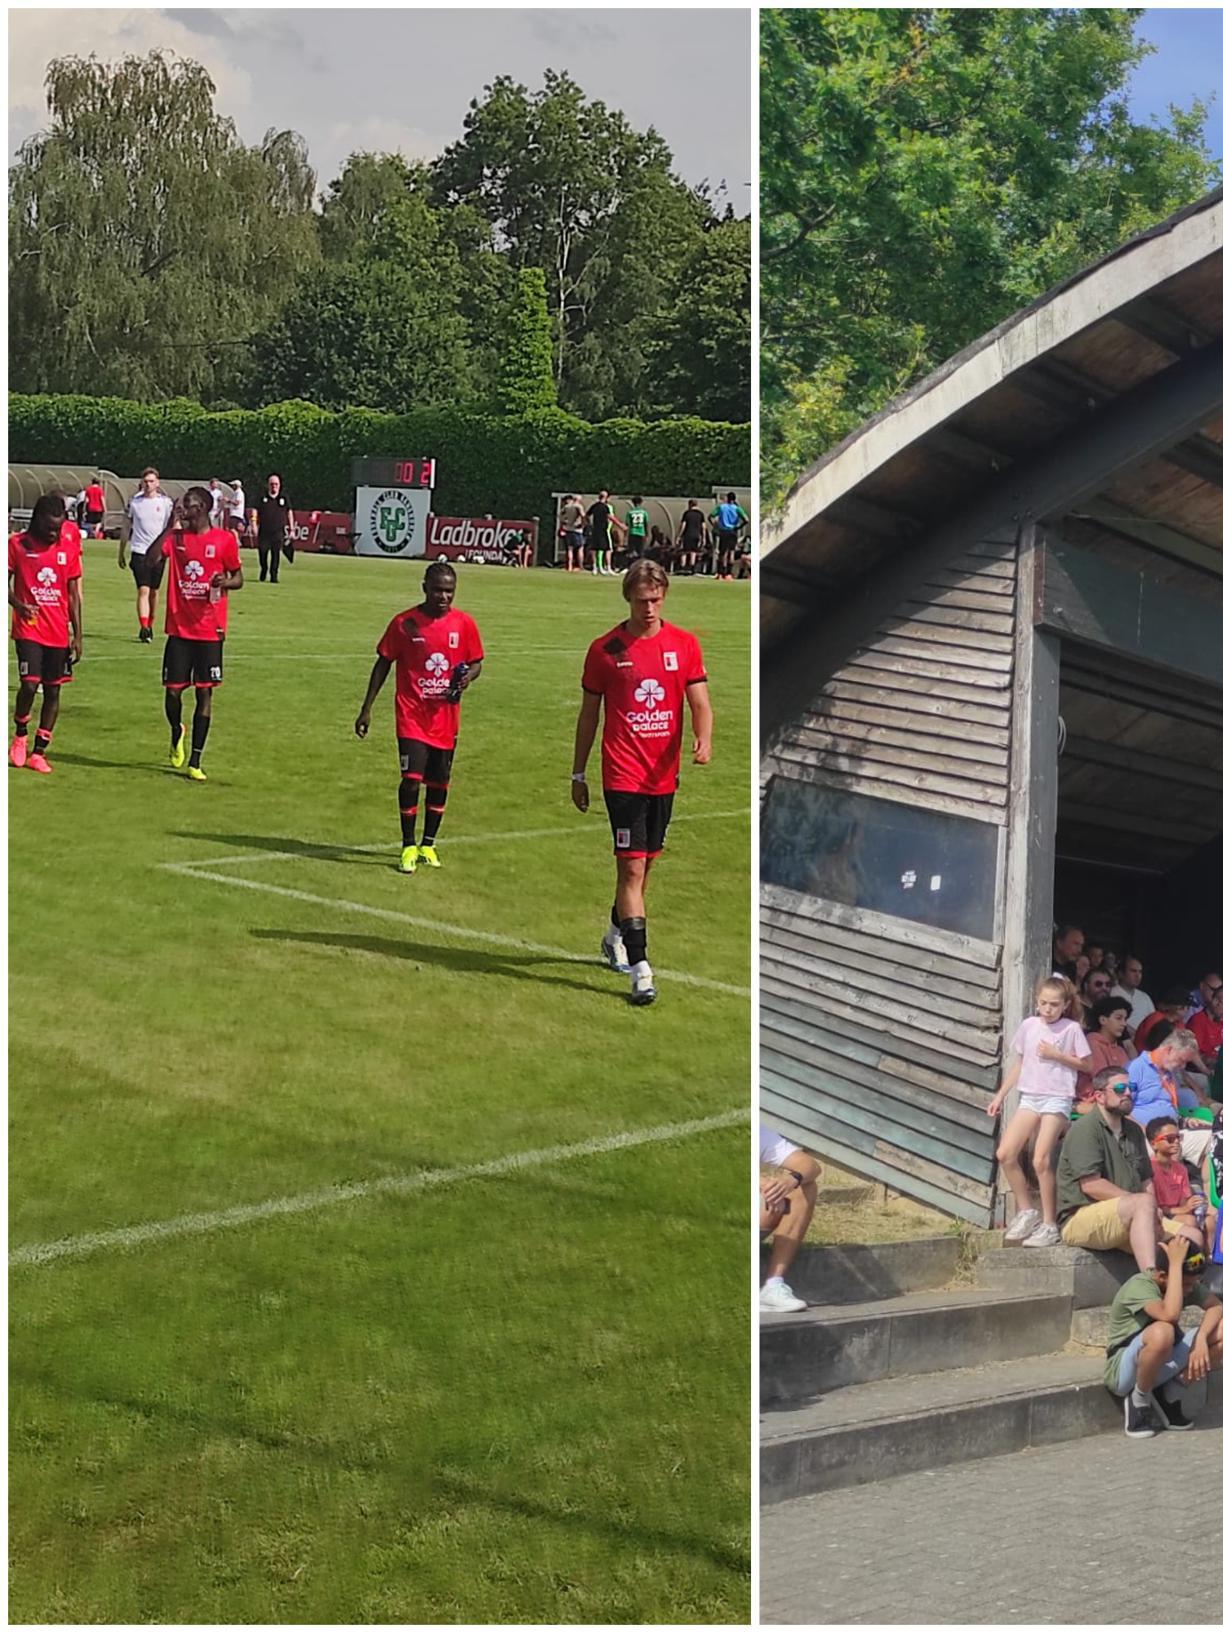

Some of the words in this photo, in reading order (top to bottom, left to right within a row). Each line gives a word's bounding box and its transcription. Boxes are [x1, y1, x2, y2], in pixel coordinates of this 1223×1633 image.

[430, 518, 524, 548] Ladbroke
[417, 677, 451, 688] Golde
[626, 709, 673, 723] Golden
